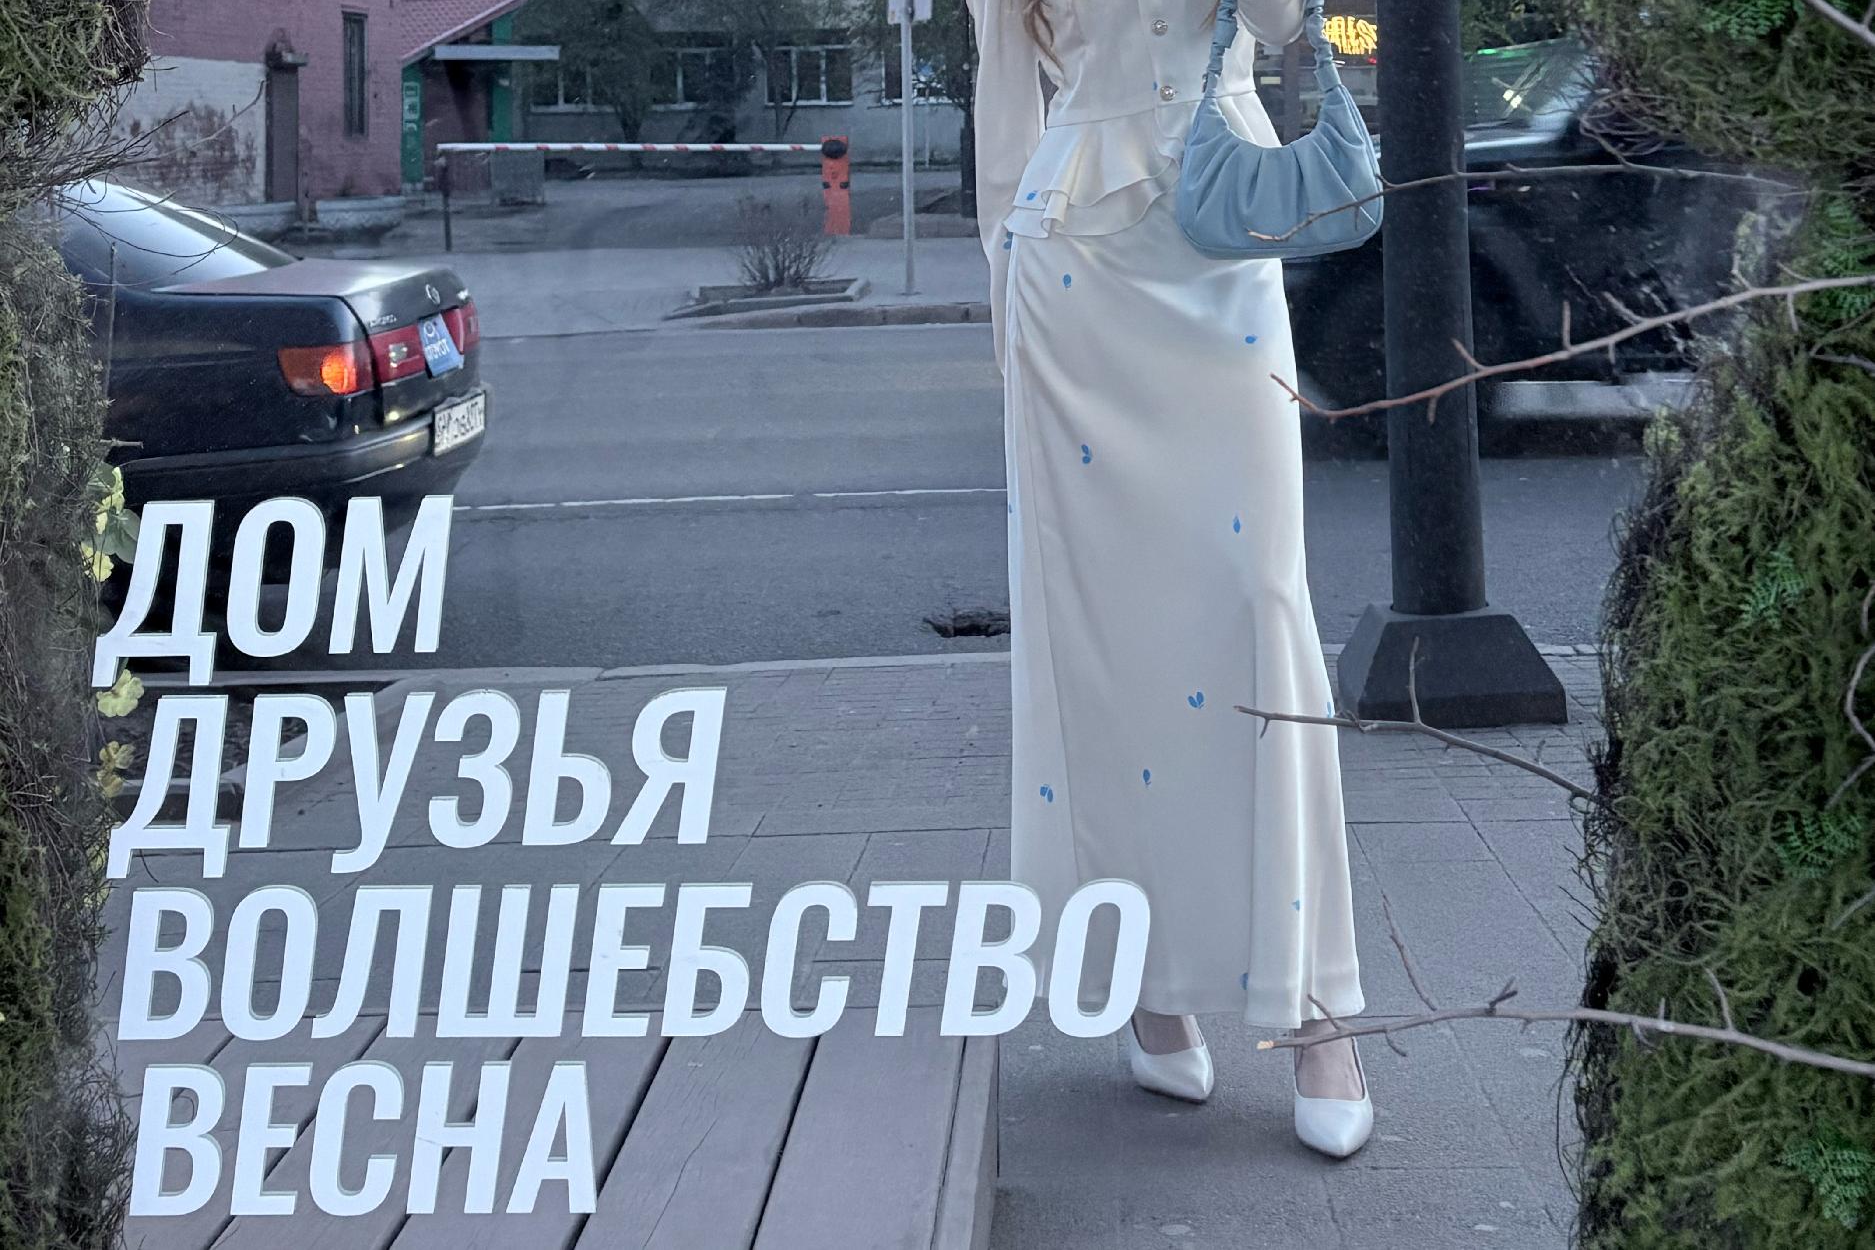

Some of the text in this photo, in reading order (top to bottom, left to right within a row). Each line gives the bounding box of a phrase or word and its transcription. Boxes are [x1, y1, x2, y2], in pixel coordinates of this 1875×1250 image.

[92, 495, 454, 687] ДОМ
[108, 687, 728, 878] ДРУЗЬЯ
[117, 879, 1151, 1040] ВОЛШЕБСТВО
[129, 1060, 598, 1216] ВЕСНА
